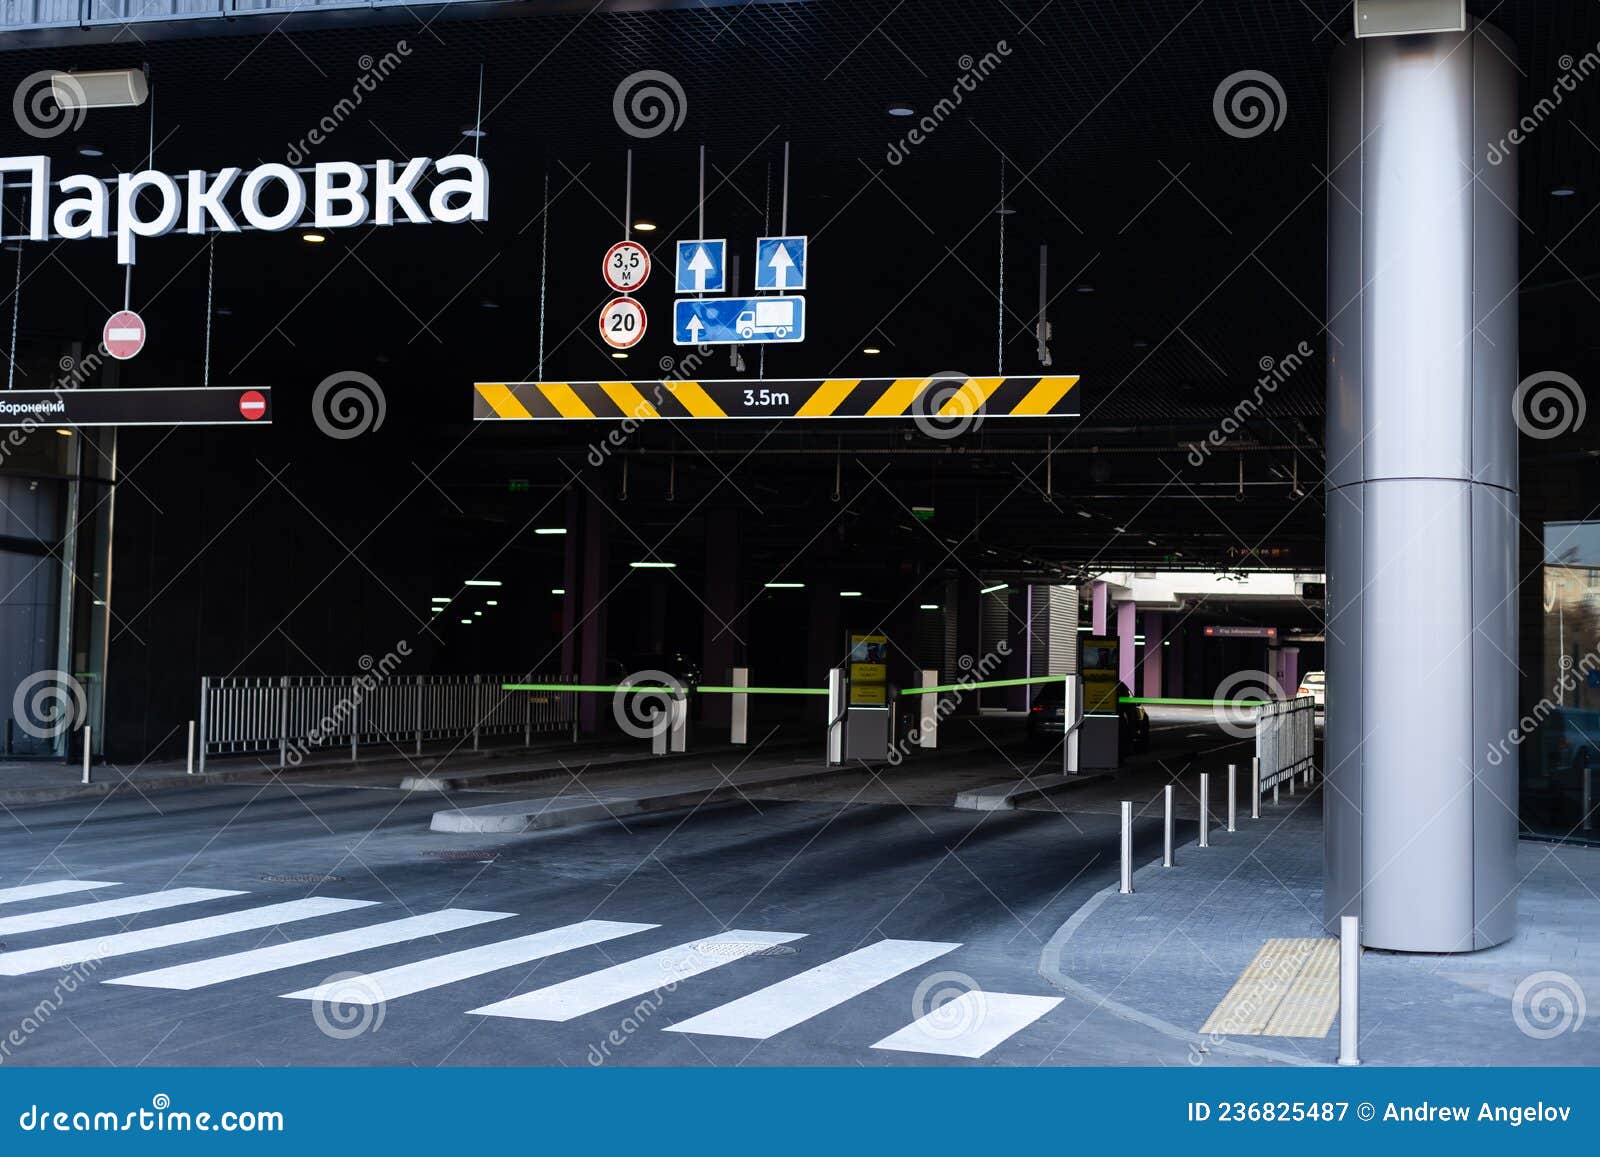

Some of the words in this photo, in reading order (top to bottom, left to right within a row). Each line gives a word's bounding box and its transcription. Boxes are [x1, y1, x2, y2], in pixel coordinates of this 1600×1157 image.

[0, 153, 489, 265] Парковка
[613, 252, 639, 270] 3,5
[611, 313, 635, 332] 20
[743, 389, 790, 406] 3.5m
